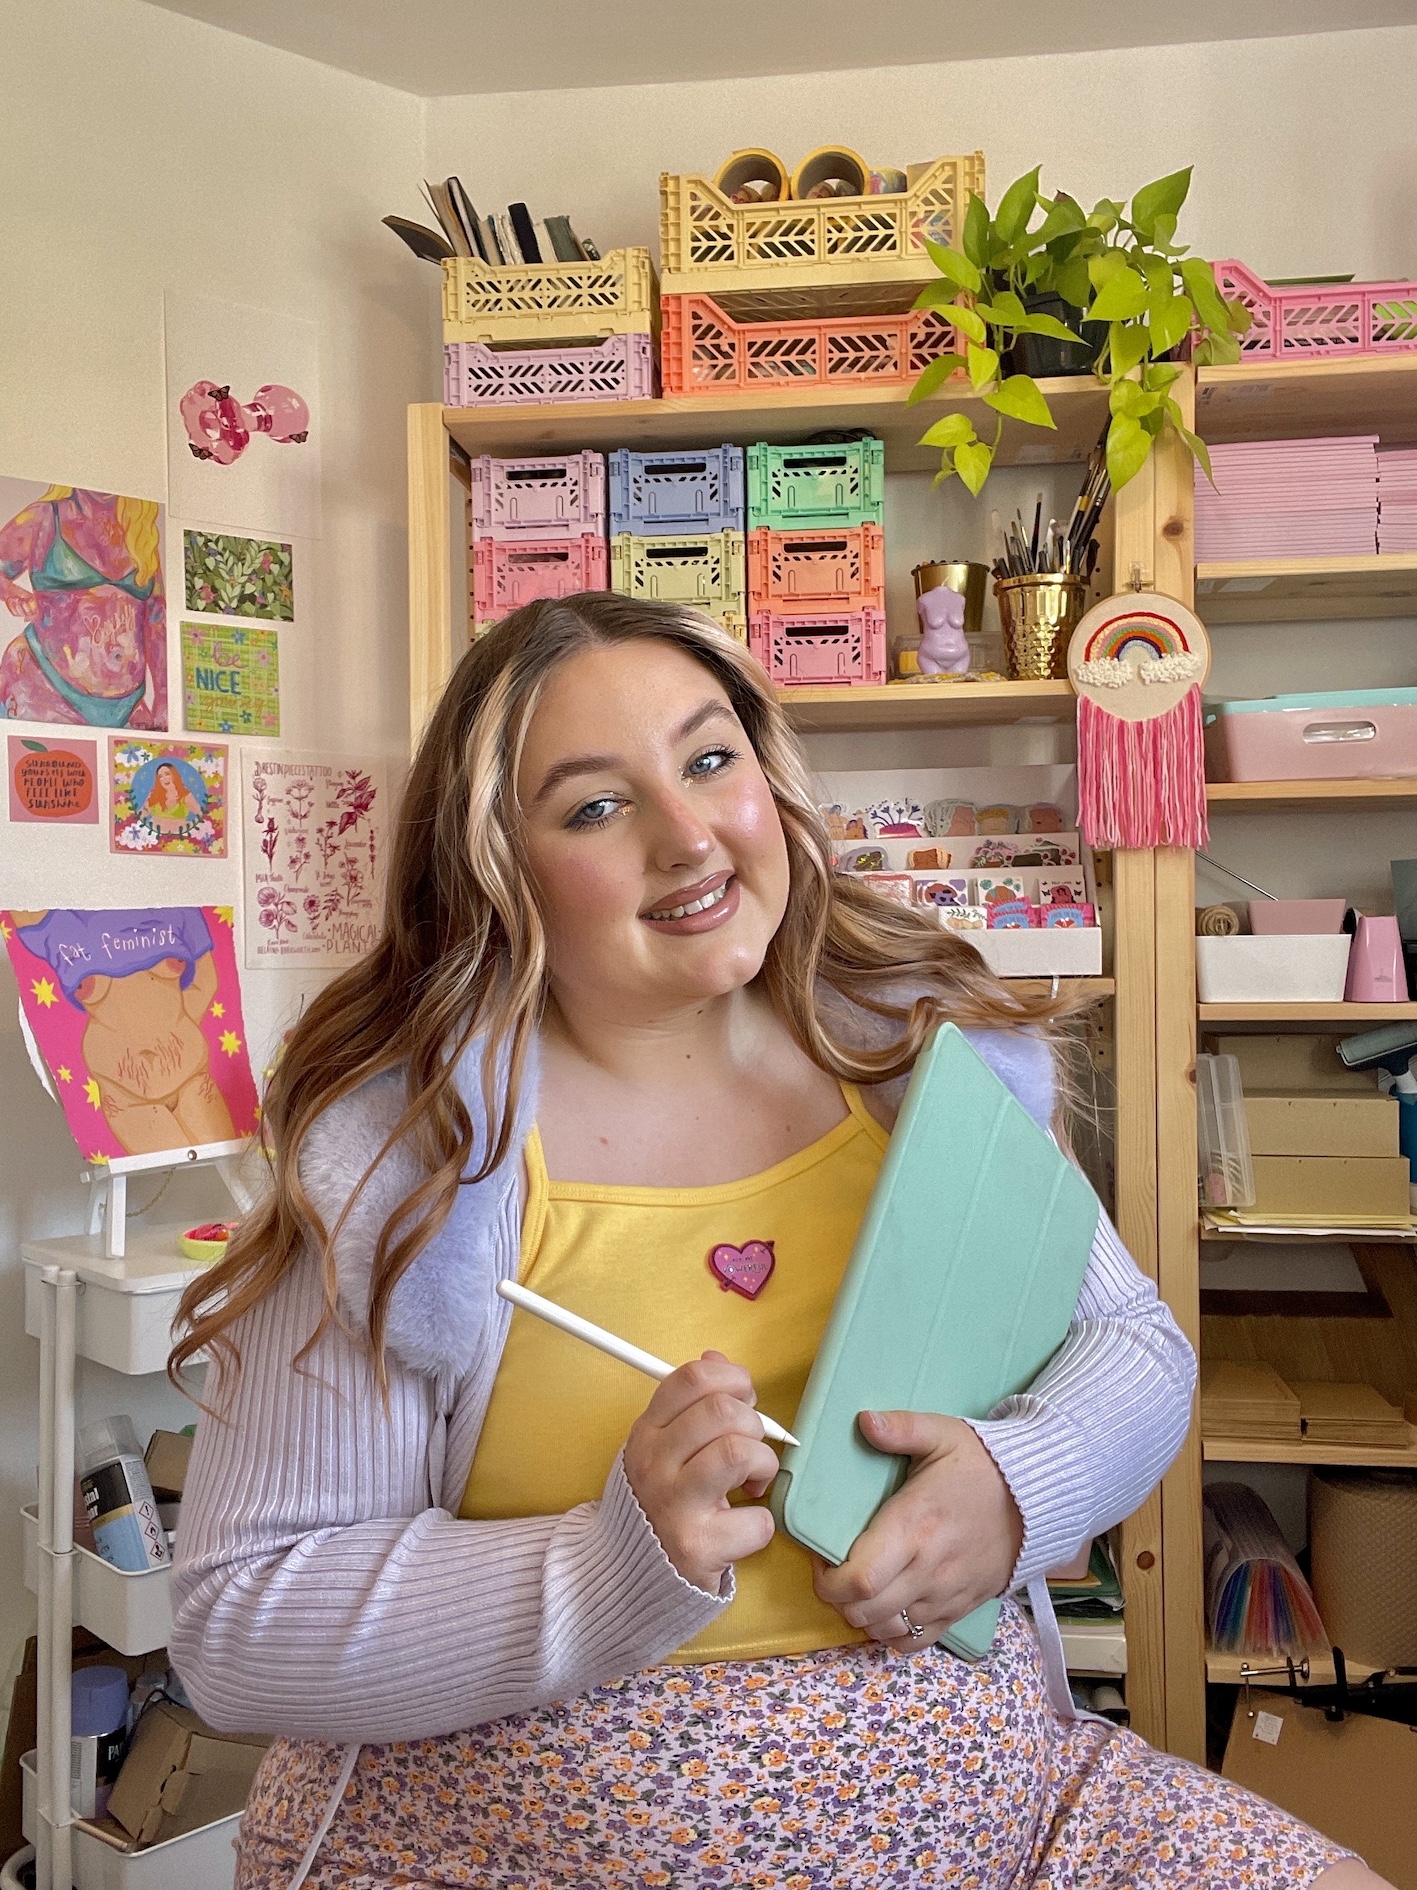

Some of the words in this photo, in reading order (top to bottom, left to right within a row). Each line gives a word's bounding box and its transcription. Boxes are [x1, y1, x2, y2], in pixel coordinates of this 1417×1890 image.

[211, 640, 248, 669] be
[195, 667, 242, 695] NICE
[23, 777, 58, 787] PEOPLE
[62, 778, 85, 787] WHO
[26, 787, 49, 798] FEEL
[54, 787, 77, 798] LIKE
[332, 922, 379, 941] MAGICAL
[58, 942, 92, 966] fat
[101, 924, 176, 959] feminist
